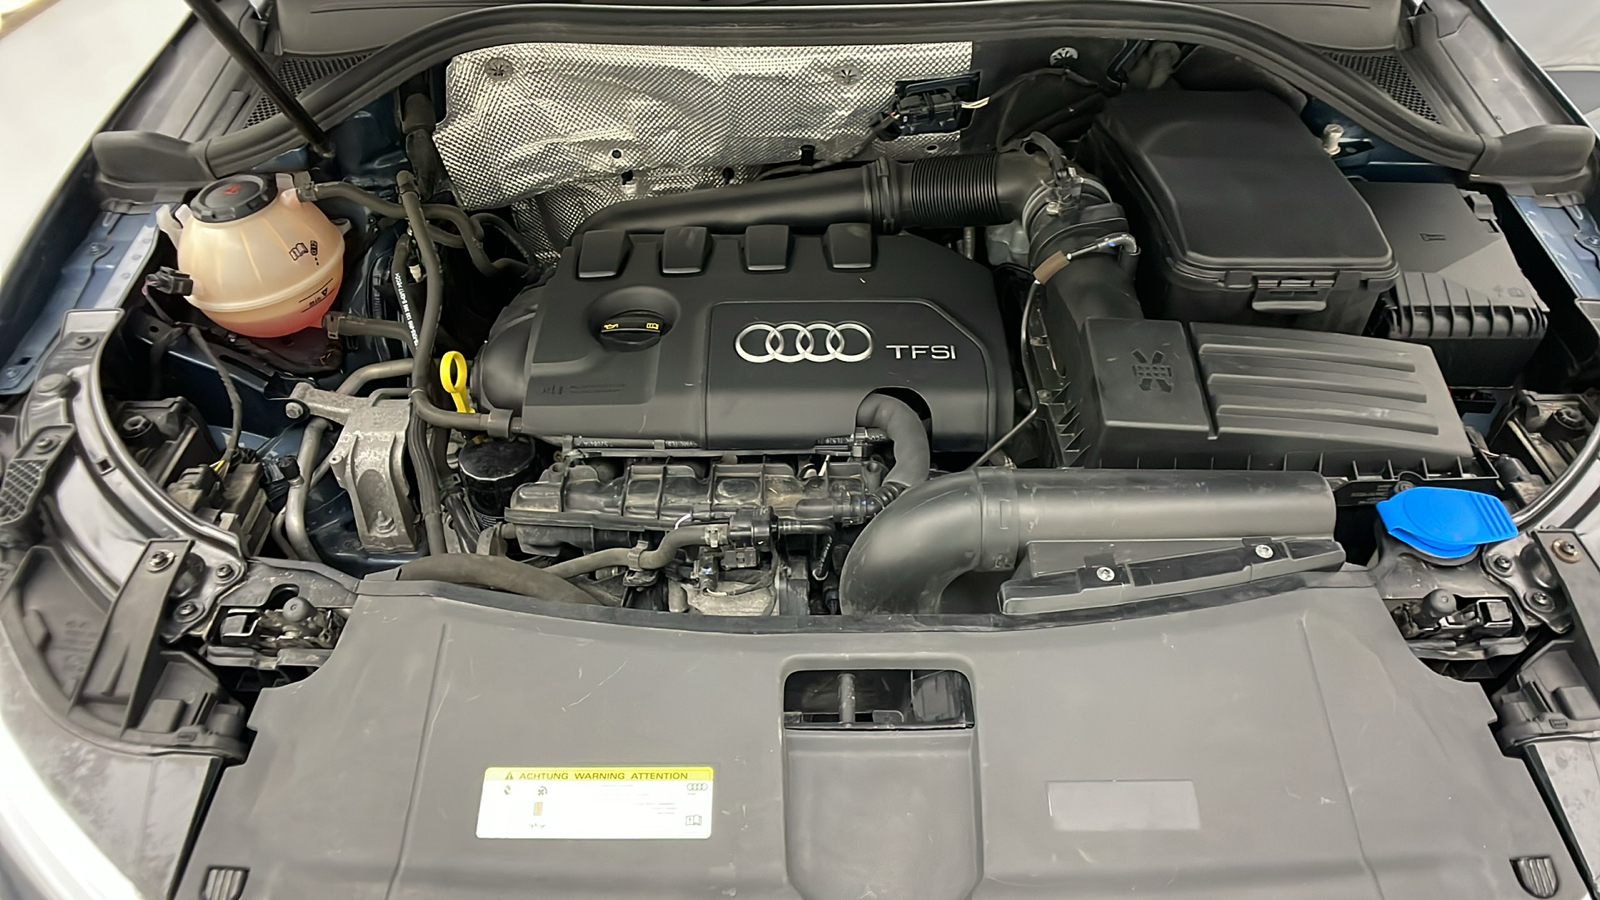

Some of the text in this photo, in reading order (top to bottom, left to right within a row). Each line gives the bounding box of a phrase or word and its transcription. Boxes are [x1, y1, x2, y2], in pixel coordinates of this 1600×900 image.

[885, 345, 956, 360] TFSI
[518, 772, 689, 780] ACHTUNG WARNING ATTENTION
